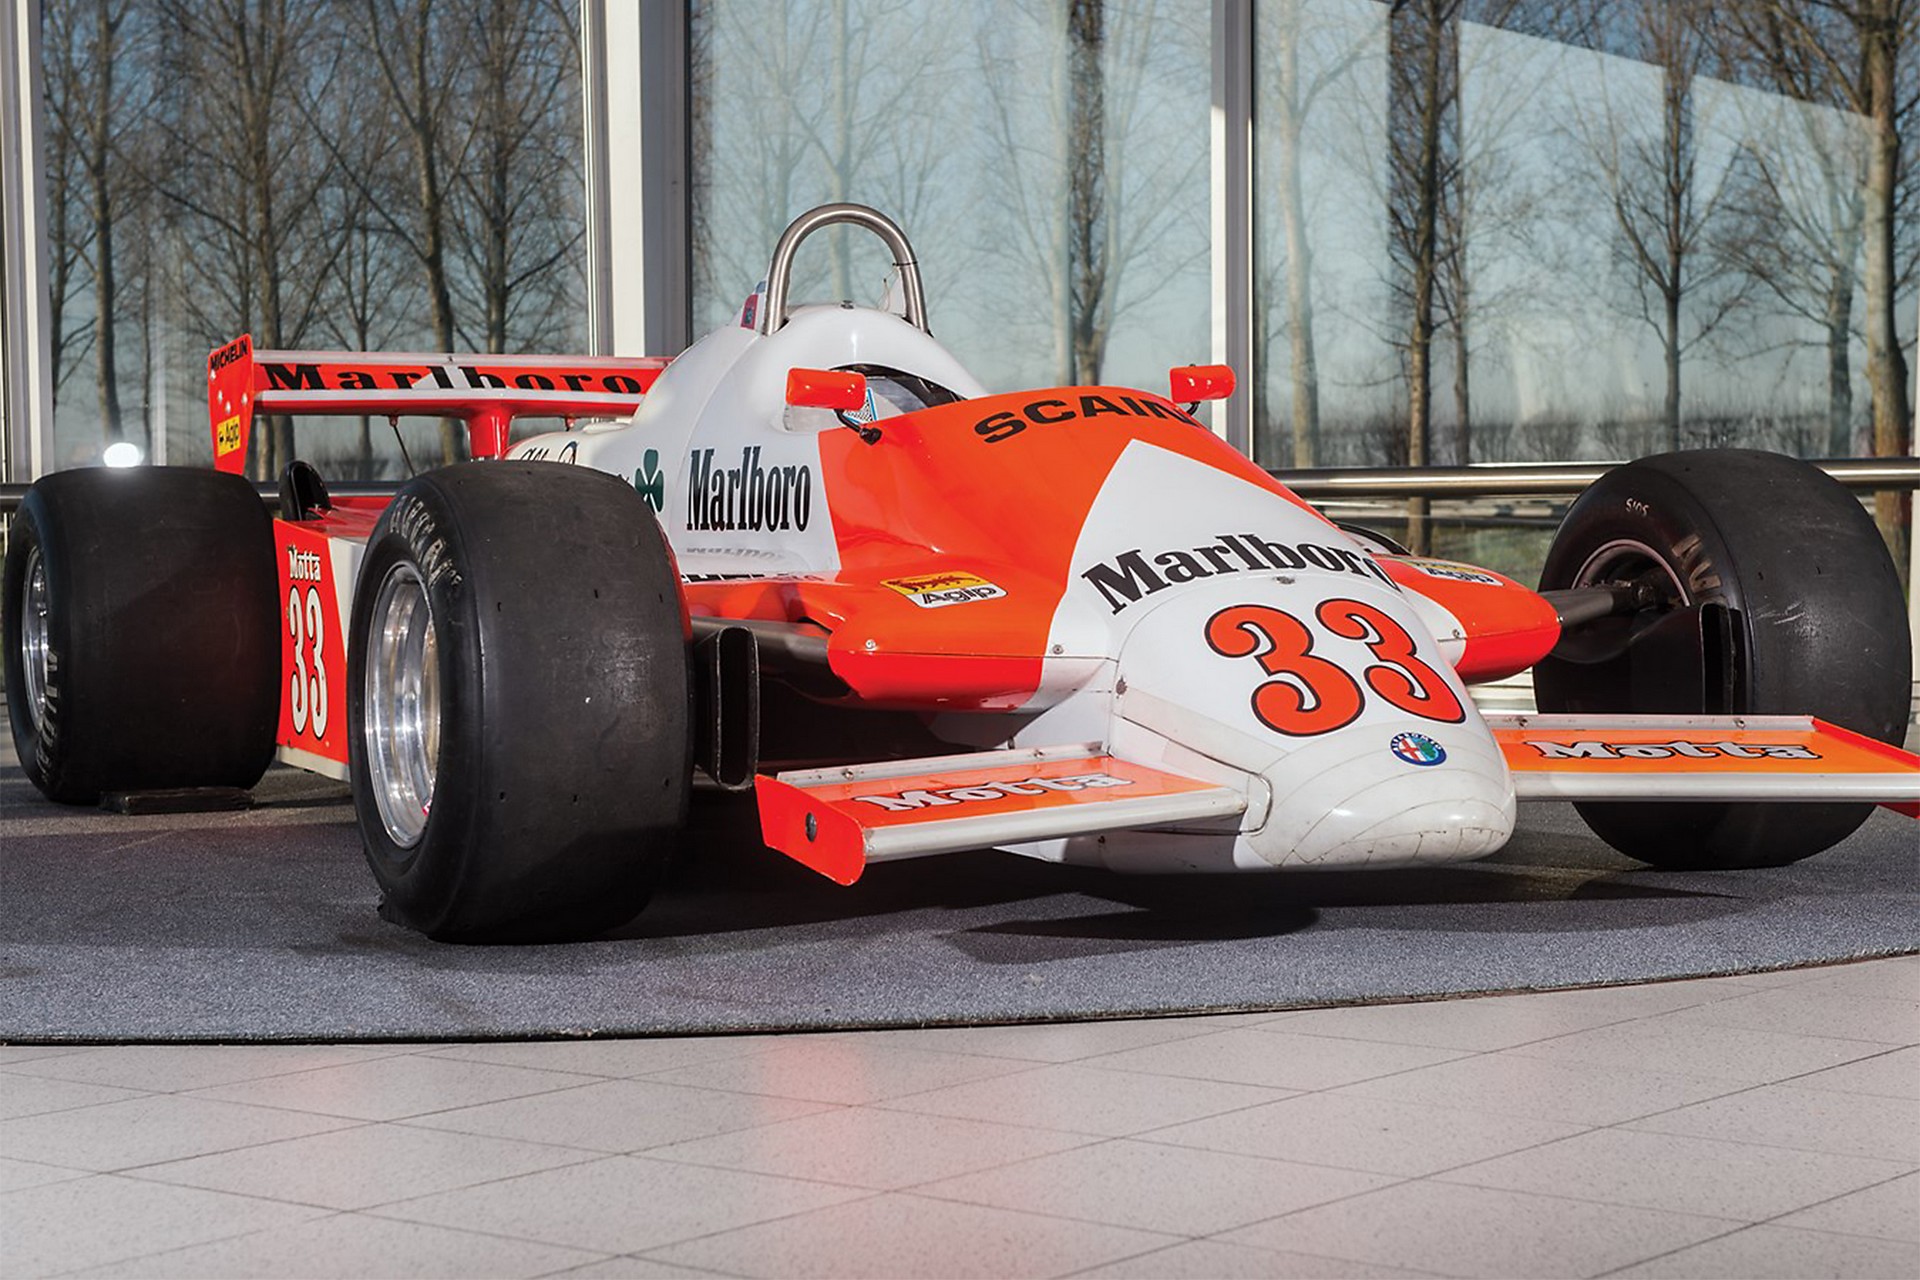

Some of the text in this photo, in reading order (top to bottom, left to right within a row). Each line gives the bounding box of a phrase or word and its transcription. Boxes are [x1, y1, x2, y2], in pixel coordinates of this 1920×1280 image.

[210, 340, 248, 370] MICHELIN
[259, 363, 643, 395] Marlboro
[686, 446, 811, 532] Marlboro
[288, 546, 322, 583] Motta
[1080, 533, 1404, 616] Marlboro
[921, 587, 998, 604] Agip
[289, 584, 328, 740] 33
[1203, 597, 1467, 737] 33
[1525, 740, 1823, 761] Motta
[852, 773, 1137, 814] Motta
